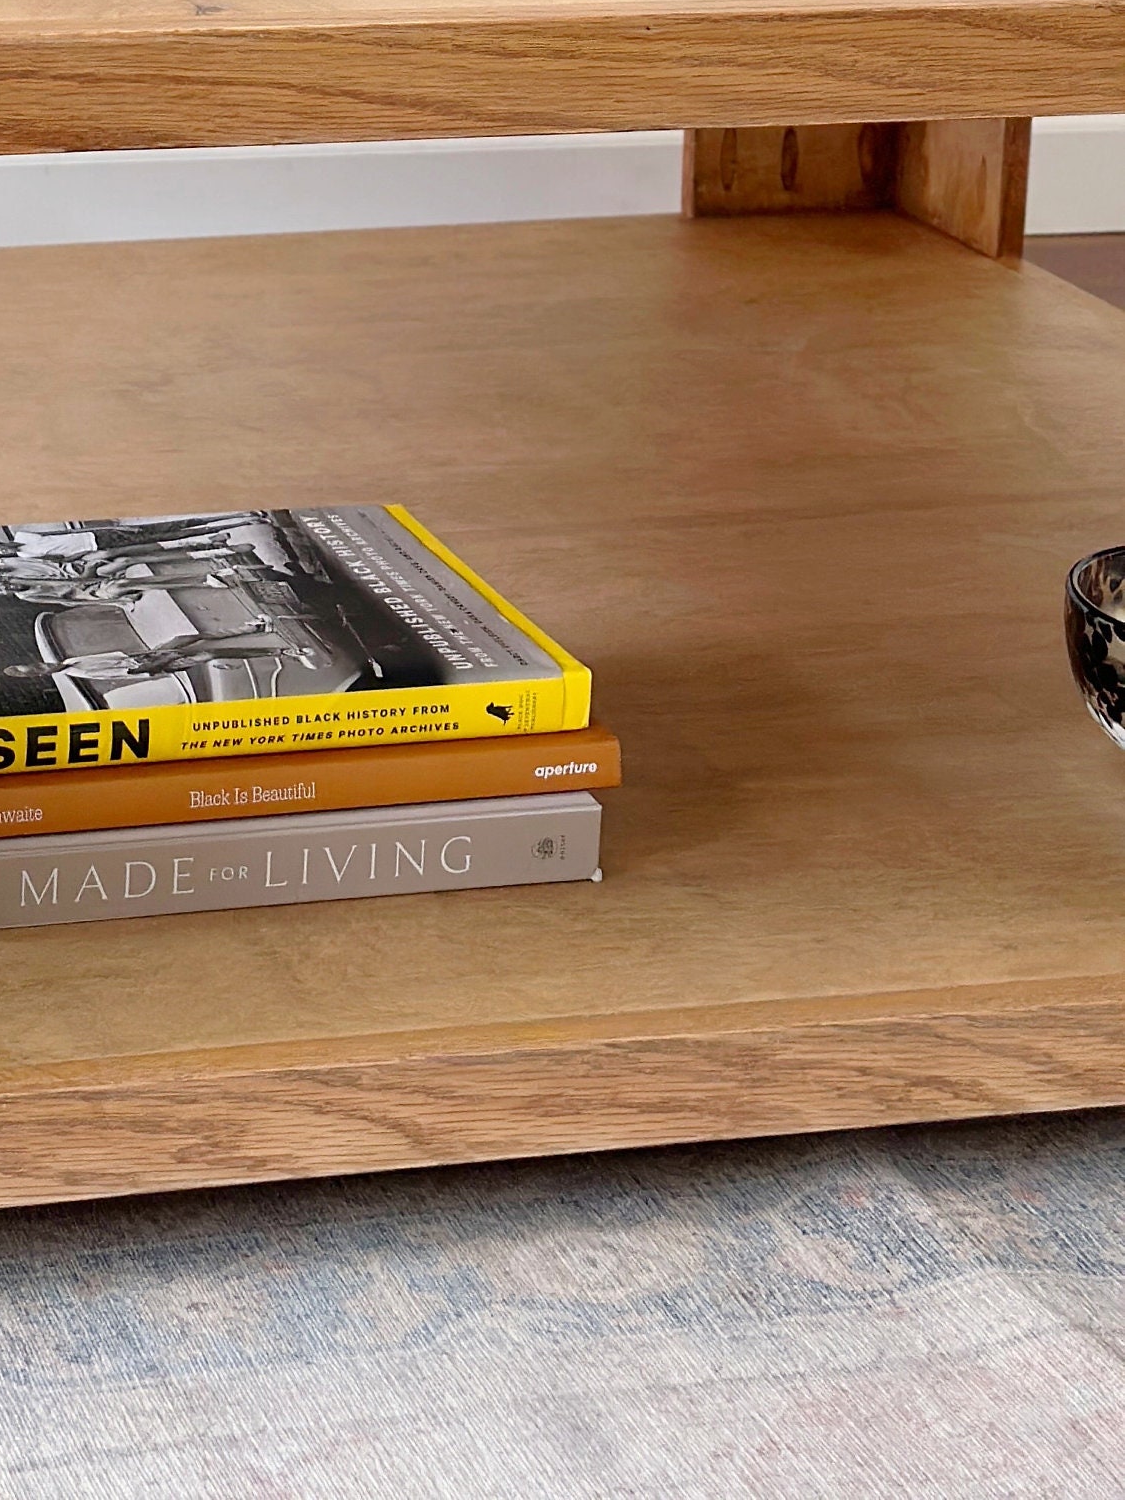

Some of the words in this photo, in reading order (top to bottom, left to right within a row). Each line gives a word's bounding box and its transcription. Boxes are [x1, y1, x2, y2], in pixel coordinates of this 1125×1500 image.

[299, 515, 356, 558] HISTORY
[345, 560, 393, 594] BLACK
[383, 596, 474, 670] UNPUBLISHED
[467, 646, 499, 668] FROM
[192, 715, 290, 732] UNPUBLISHED
[296, 711, 341, 725] BLACK
[346, 707, 406, 721] HISTORY
[412, 703, 451, 716] FROM
[180, 740, 208, 751] THE
[212, 736, 244, 749] NEW
[249, 733, 286, 746] YORK
[291, 730, 334, 743] TIMES
[338, 726, 385, 739] PHOTO
[390, 721, 460, 736] ARCHIVES
[534, 759, 598, 780] aperture
[189, 787, 230, 809] Black
[233, 785, 249, 805] Is
[251, 781, 317, 804] Beautiful
[19, 856, 196, 908] MADE
[208, 865, 250, 883] FOR
[264, 835, 473, 888] LIVING
